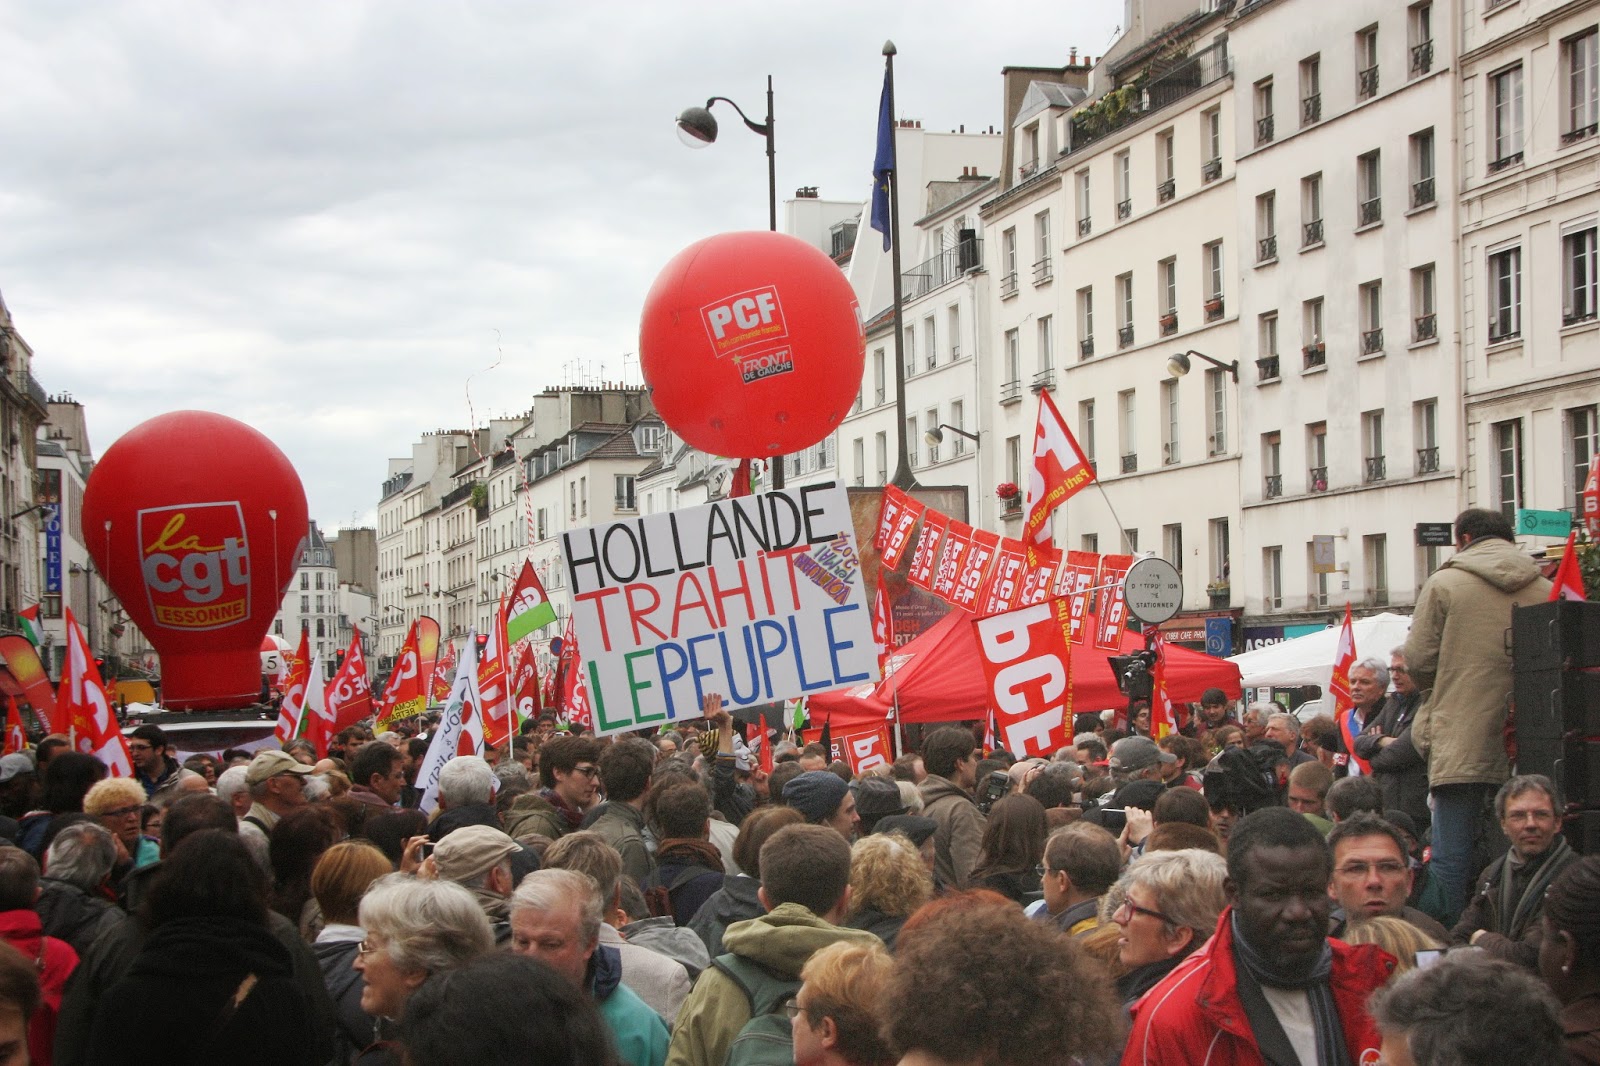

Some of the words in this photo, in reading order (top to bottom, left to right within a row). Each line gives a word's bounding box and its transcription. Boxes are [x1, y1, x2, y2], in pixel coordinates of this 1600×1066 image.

[708, 292, 776, 340] PCF
[743, 350, 789, 374] FRONT
[744, 371, 756, 381] DE
[757, 361, 792, 377] GAUCHE
[47, 505, 61, 579] HOTEL
[145, 512, 226, 553] la
[562, 480, 839, 595] HOLLANDE
[143, 537, 250, 603] cgt
[814, 545, 844, 571] MAI
[162, 601, 243, 623] ESSONNE
[574, 543, 812, 652] TRAHIT
[1165, 631, 1179, 640] CYBER
[1180, 631, 1192, 639] CAFE
[267, 655, 278, 669] 5
